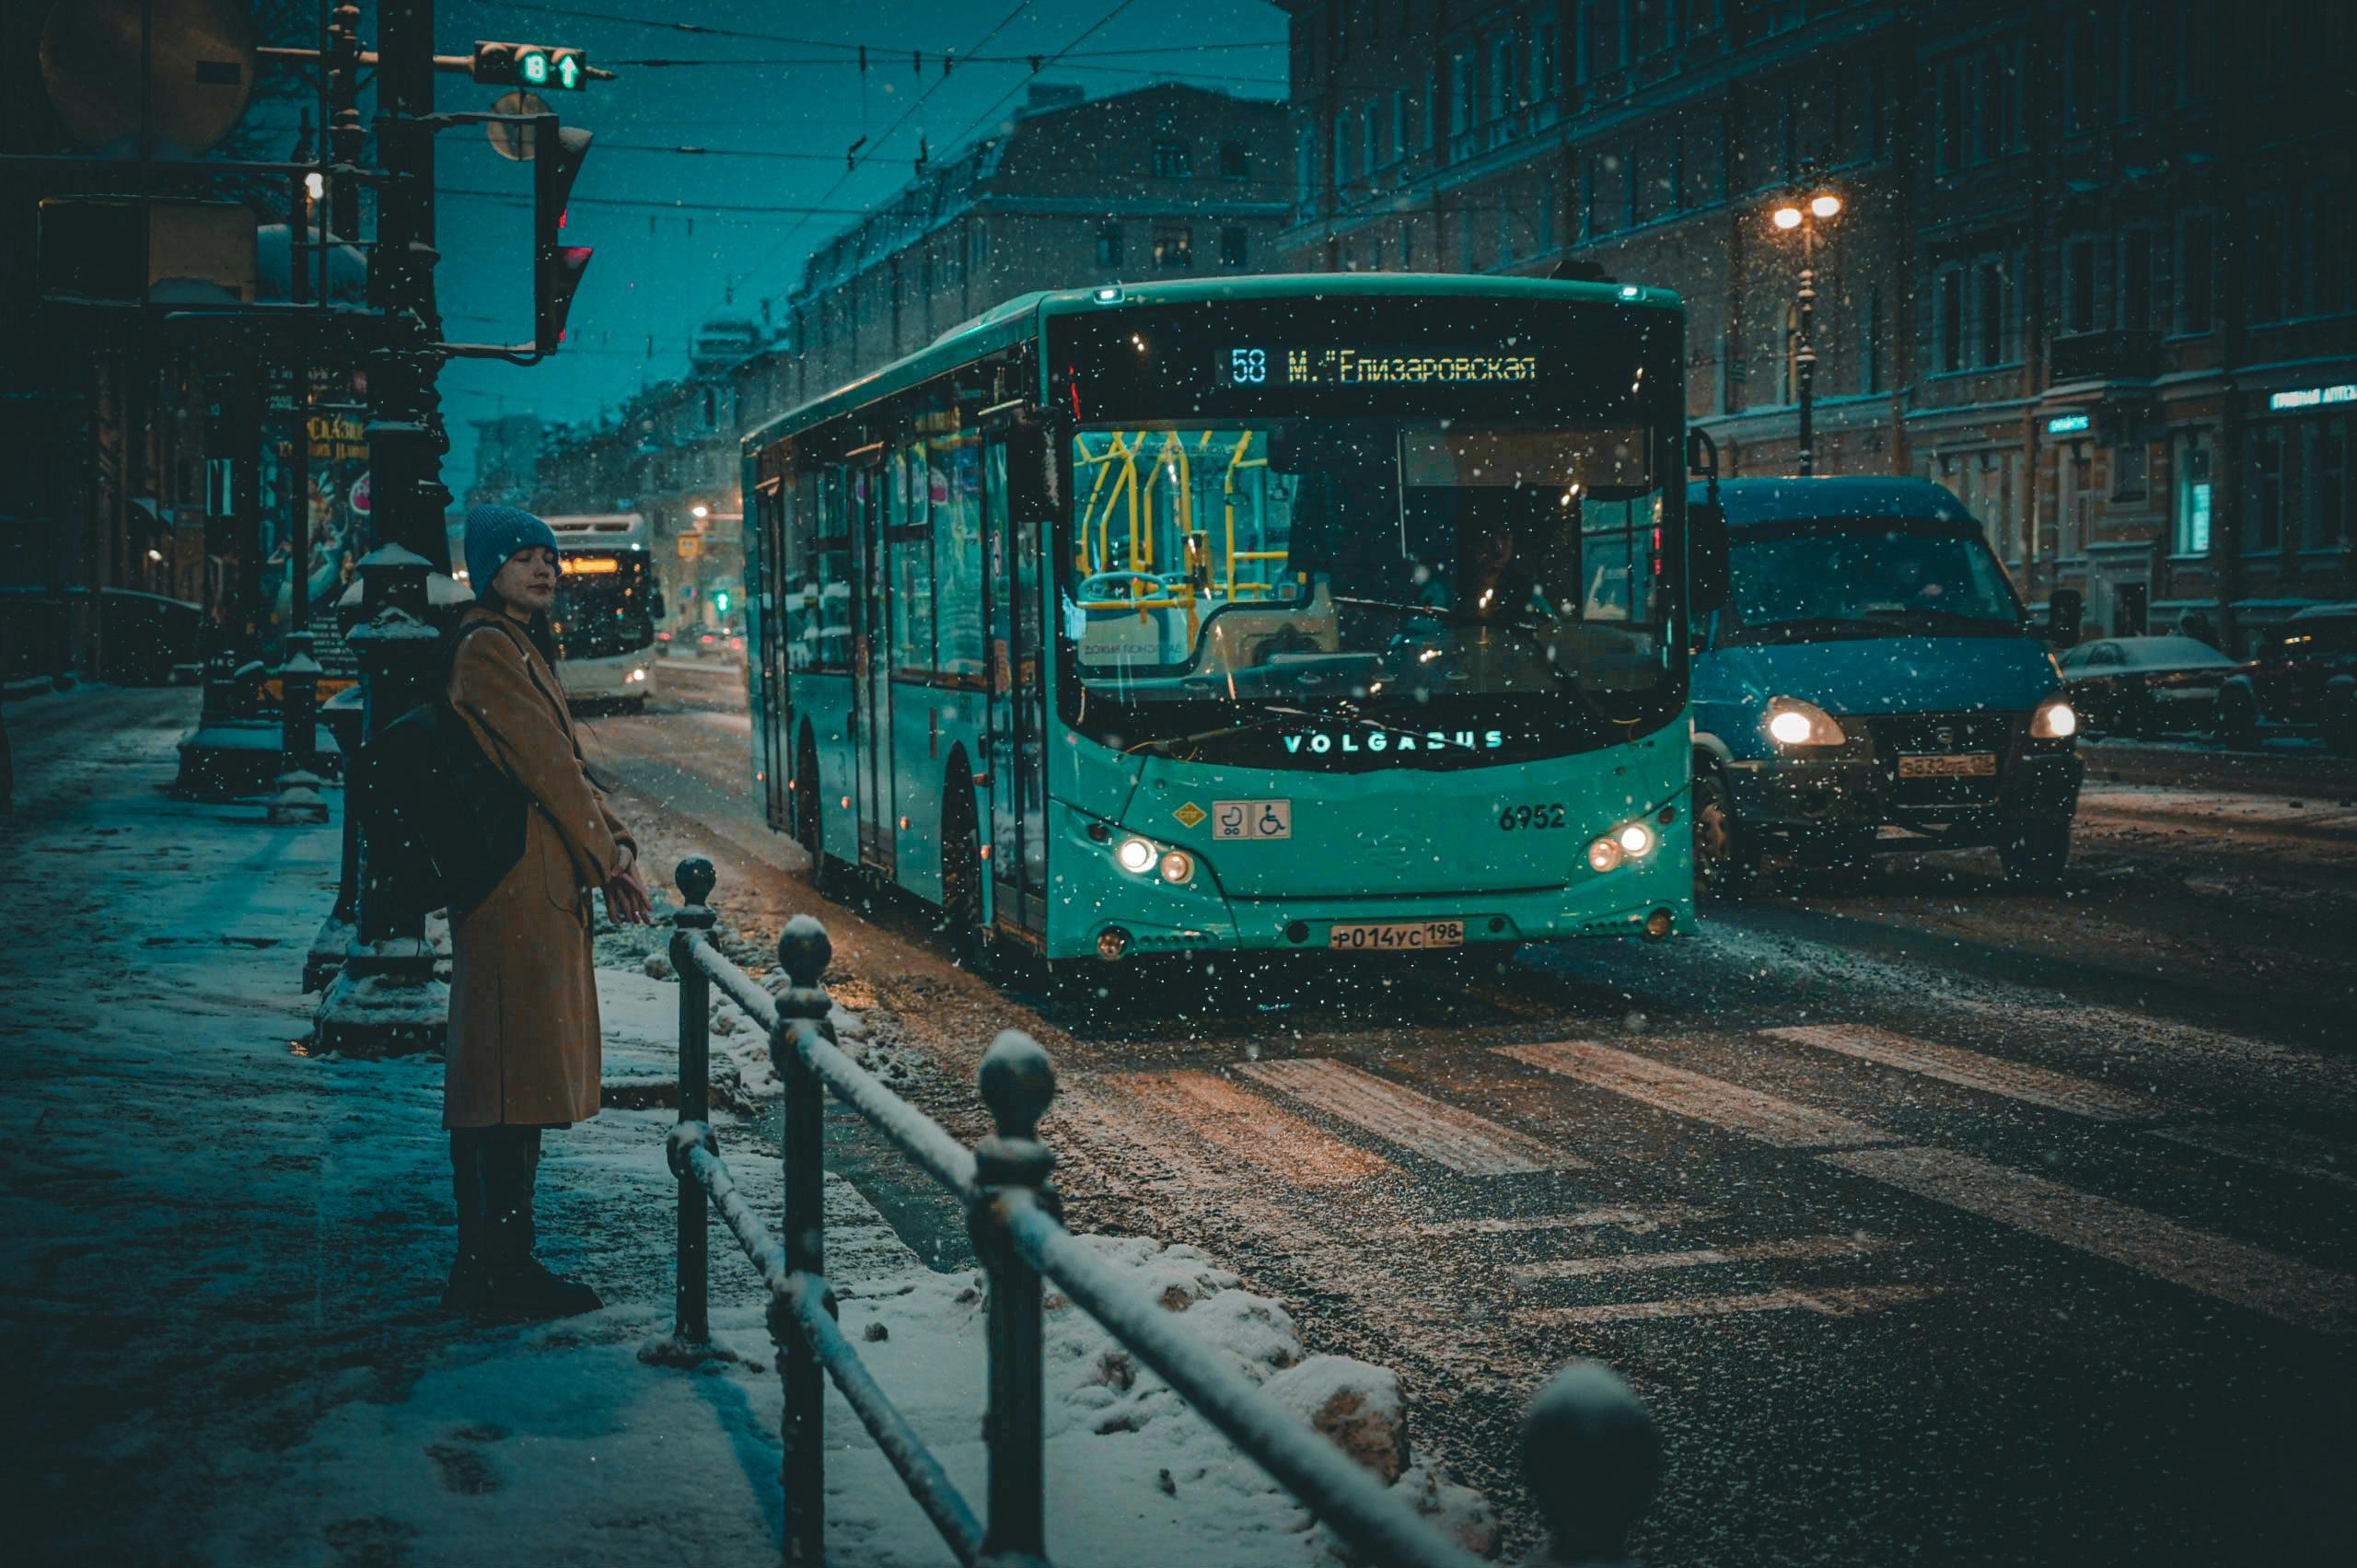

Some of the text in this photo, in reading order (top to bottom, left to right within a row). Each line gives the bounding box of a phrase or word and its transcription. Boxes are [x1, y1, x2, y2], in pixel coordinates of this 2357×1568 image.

[1231, 348, 1265, 383] 58
[1283, 730, 1504, 753] VOLGABUS
[1499, 803, 1566, 830] 6952
[1427, 923, 1458, 939] 198
